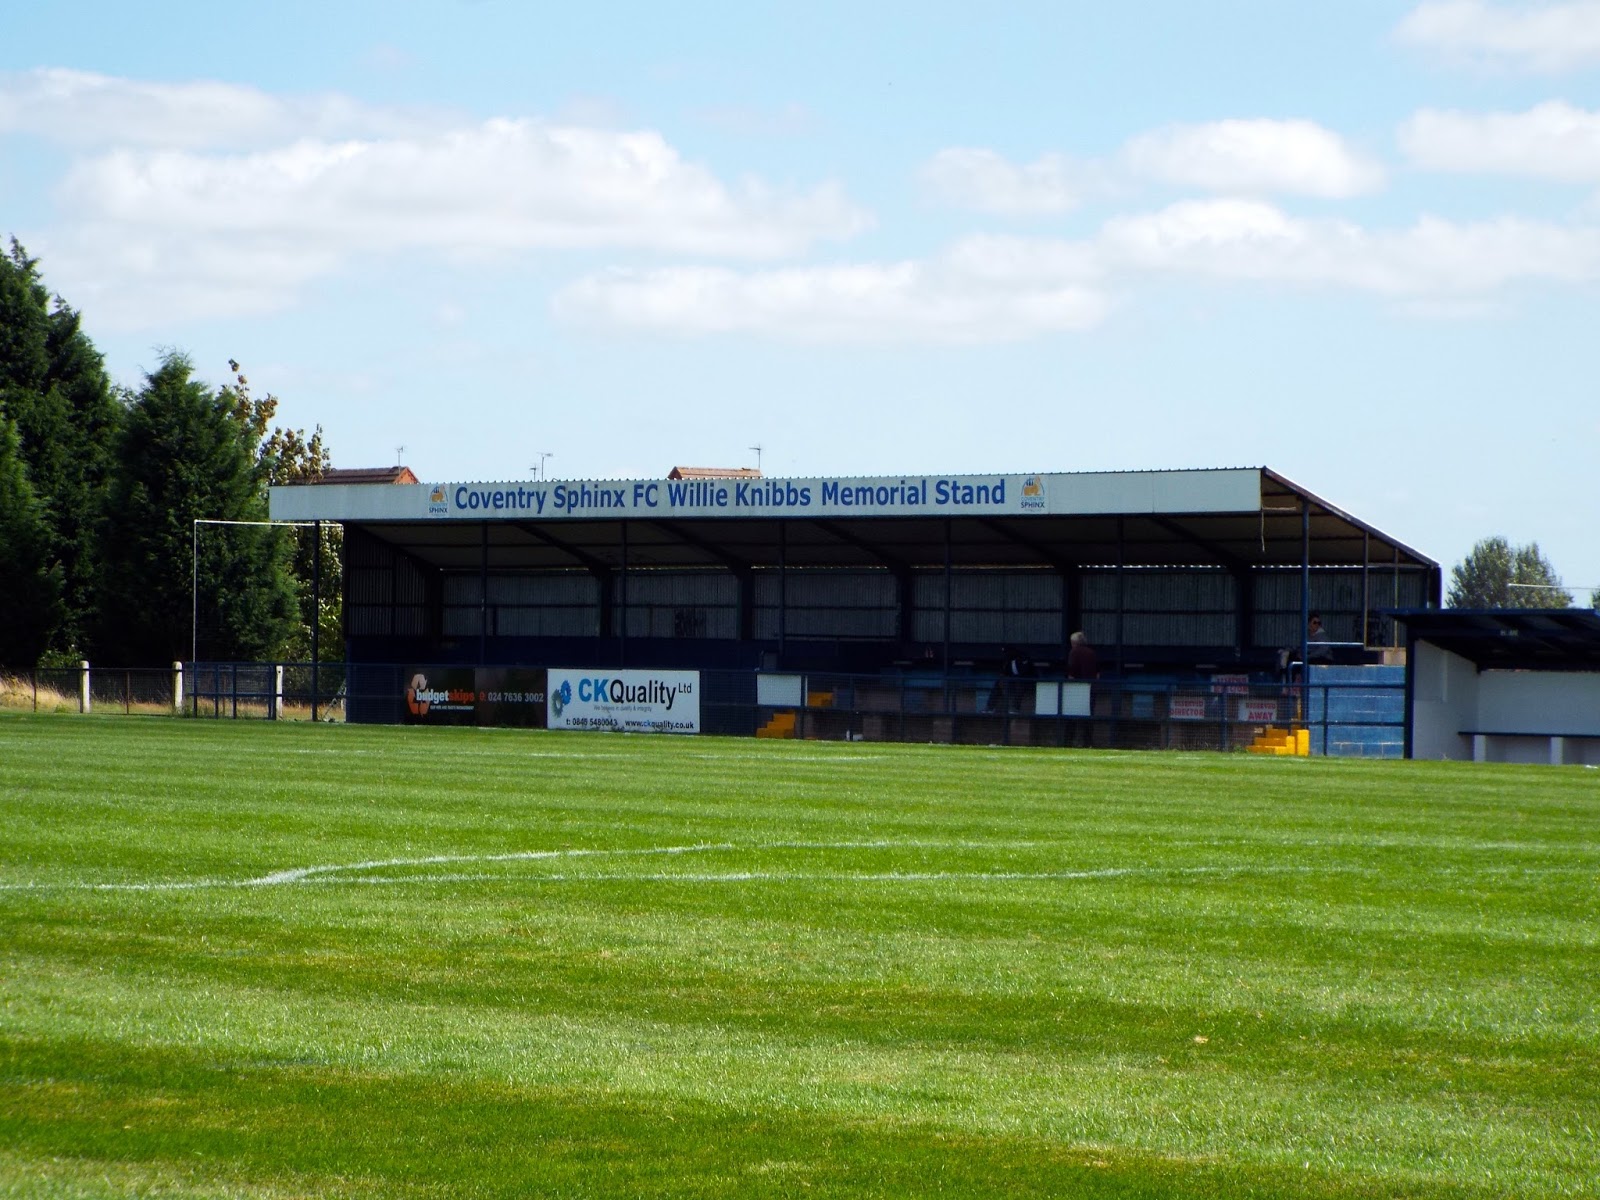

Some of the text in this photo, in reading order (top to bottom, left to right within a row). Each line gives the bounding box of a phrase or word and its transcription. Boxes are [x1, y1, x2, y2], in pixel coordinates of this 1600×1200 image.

[455, 478, 1006, 514] Coventry Sphinx FC Willie Knibbs Memorial Stand
[678, 682, 692, 694] Ltd
[488, 691, 502, 702] 024
[503, 692, 522, 702] 7636
[524, 692, 544, 703] 3002
[1248, 711, 1273, 720] AWAY
